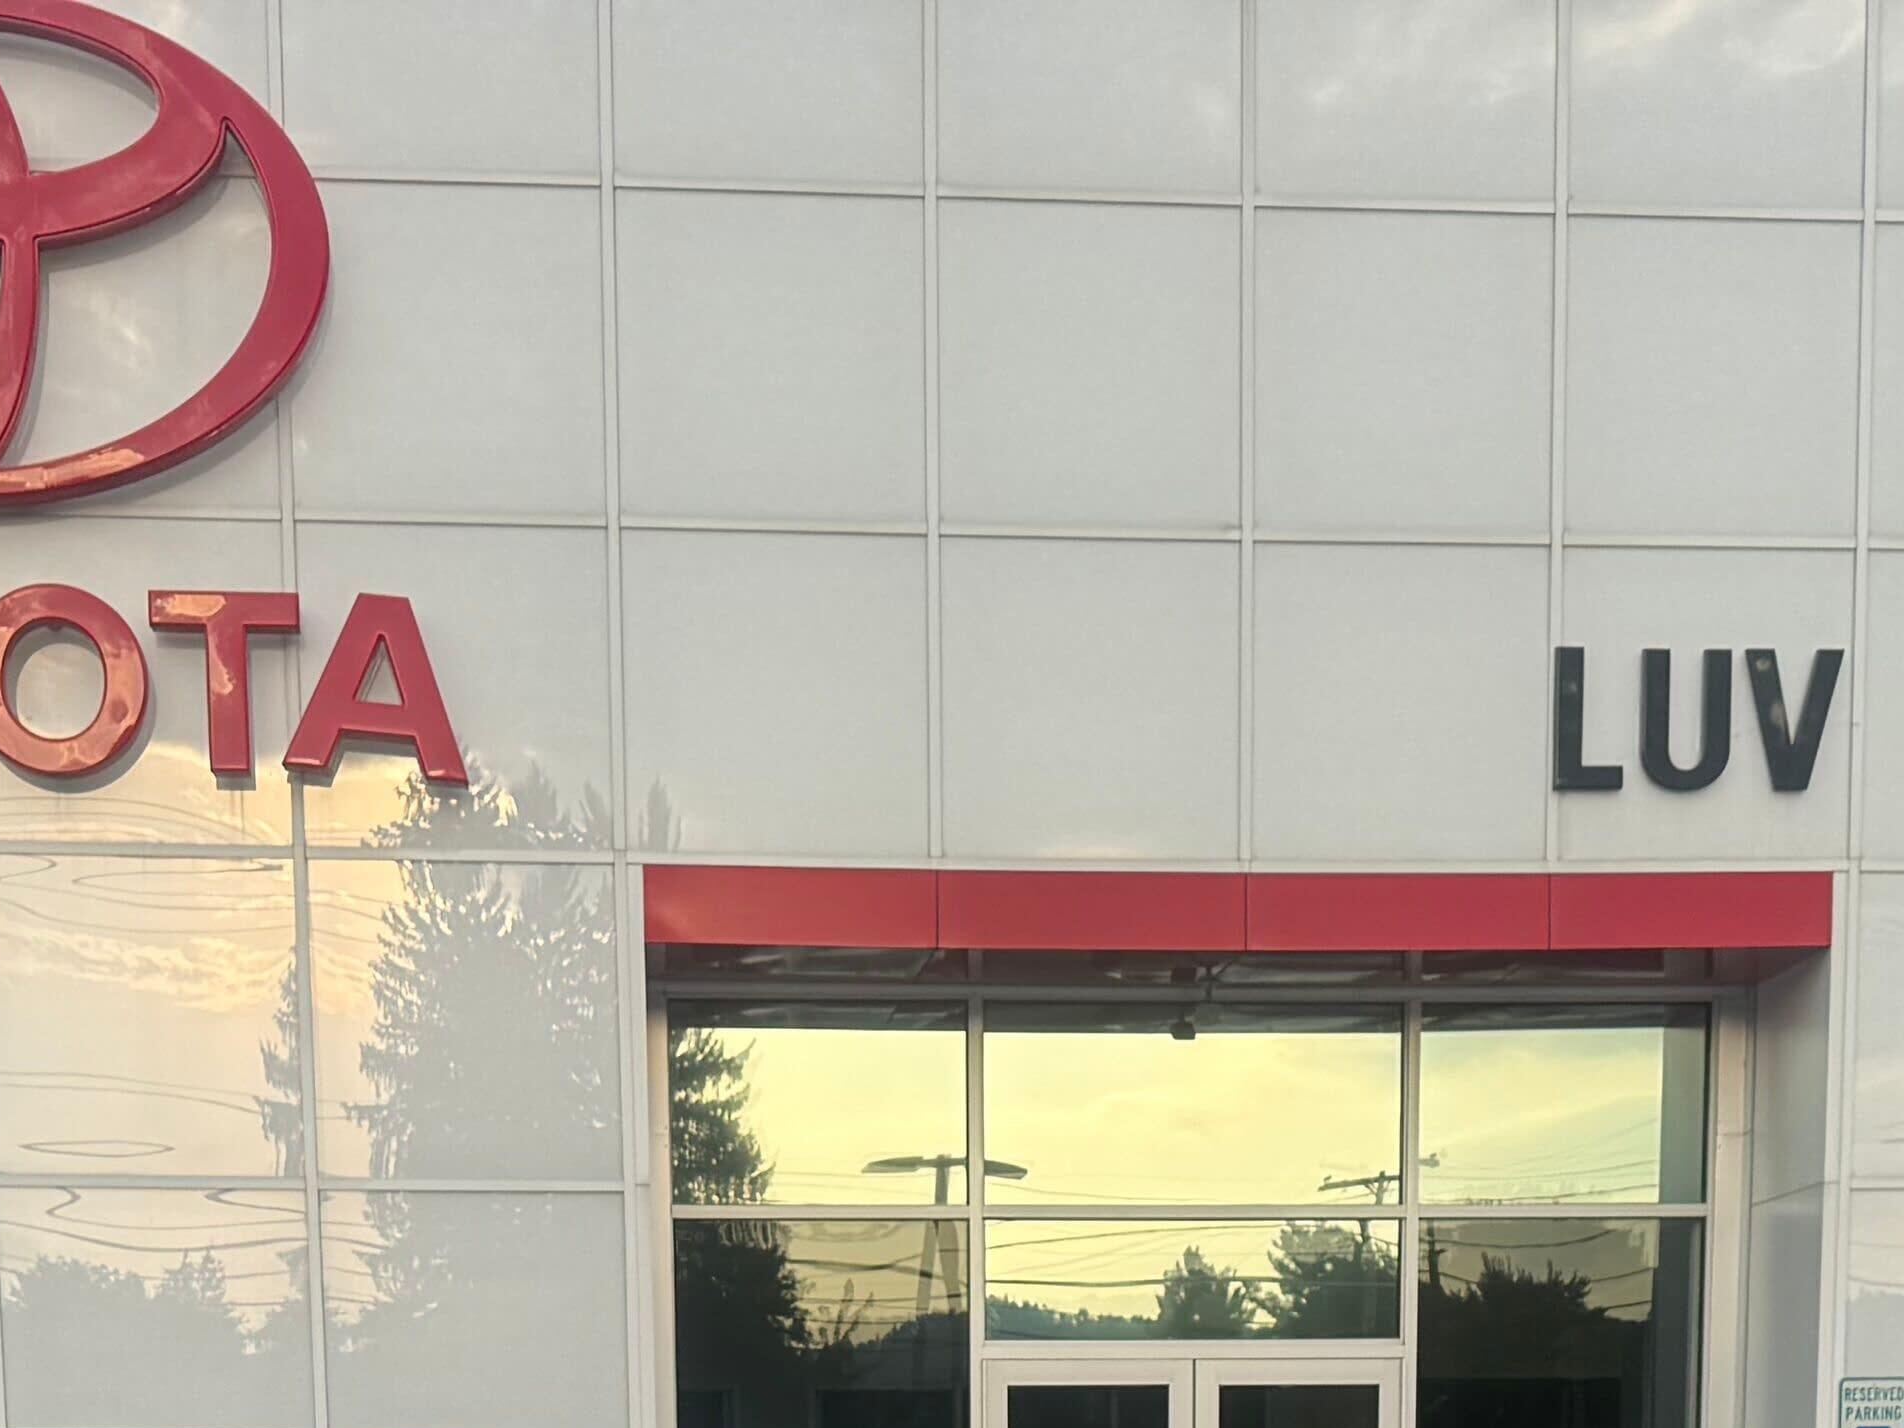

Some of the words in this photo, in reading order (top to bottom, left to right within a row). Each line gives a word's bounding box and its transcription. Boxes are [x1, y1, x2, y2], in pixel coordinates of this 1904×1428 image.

[1553, 646, 1845, 791] LUV
[1844, 1386, 1904, 1402] RESERVED
[1845, 1406, 1902, 1421] PARKING
